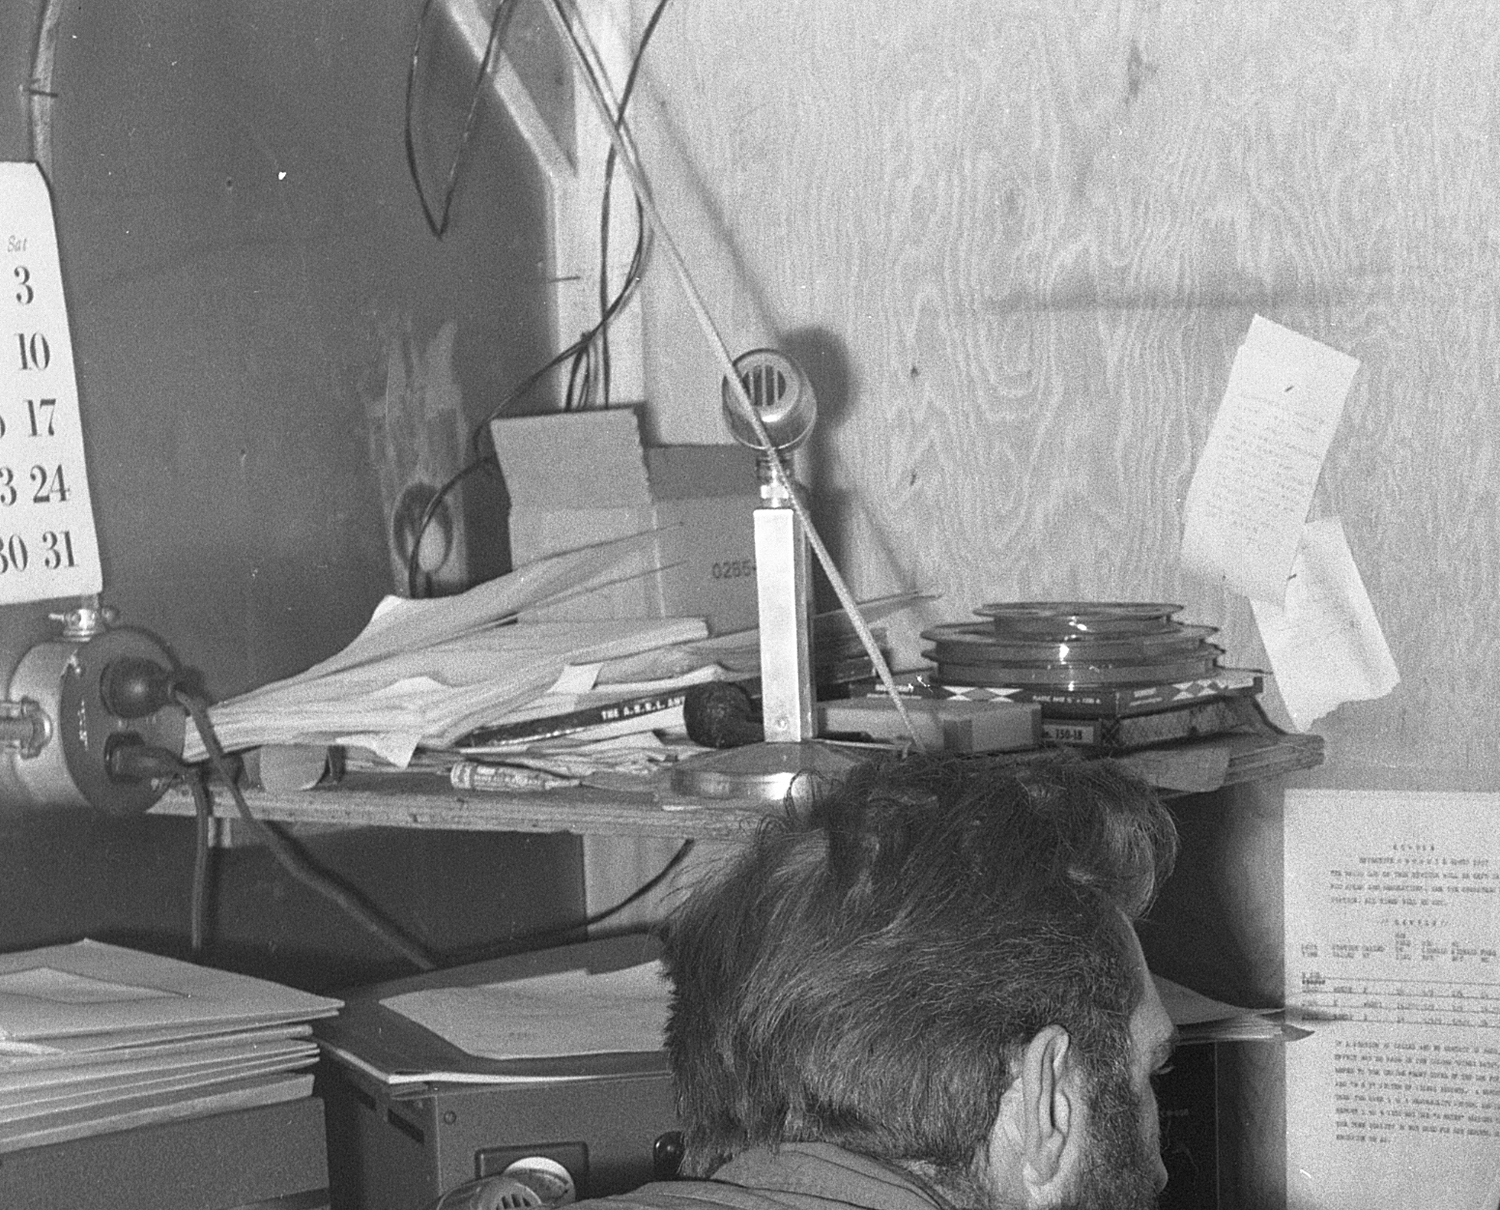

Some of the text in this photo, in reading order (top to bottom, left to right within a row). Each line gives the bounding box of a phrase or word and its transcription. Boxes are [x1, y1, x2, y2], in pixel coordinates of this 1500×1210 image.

[14, 265, 34, 305] 3
[15, 332, 51, 371] 10
[25, 398, 57, 438] 17
[30, 464, 71, 504] 24
[43, 530, 78, 570] 31
[601, 708, 619, 720] THE
